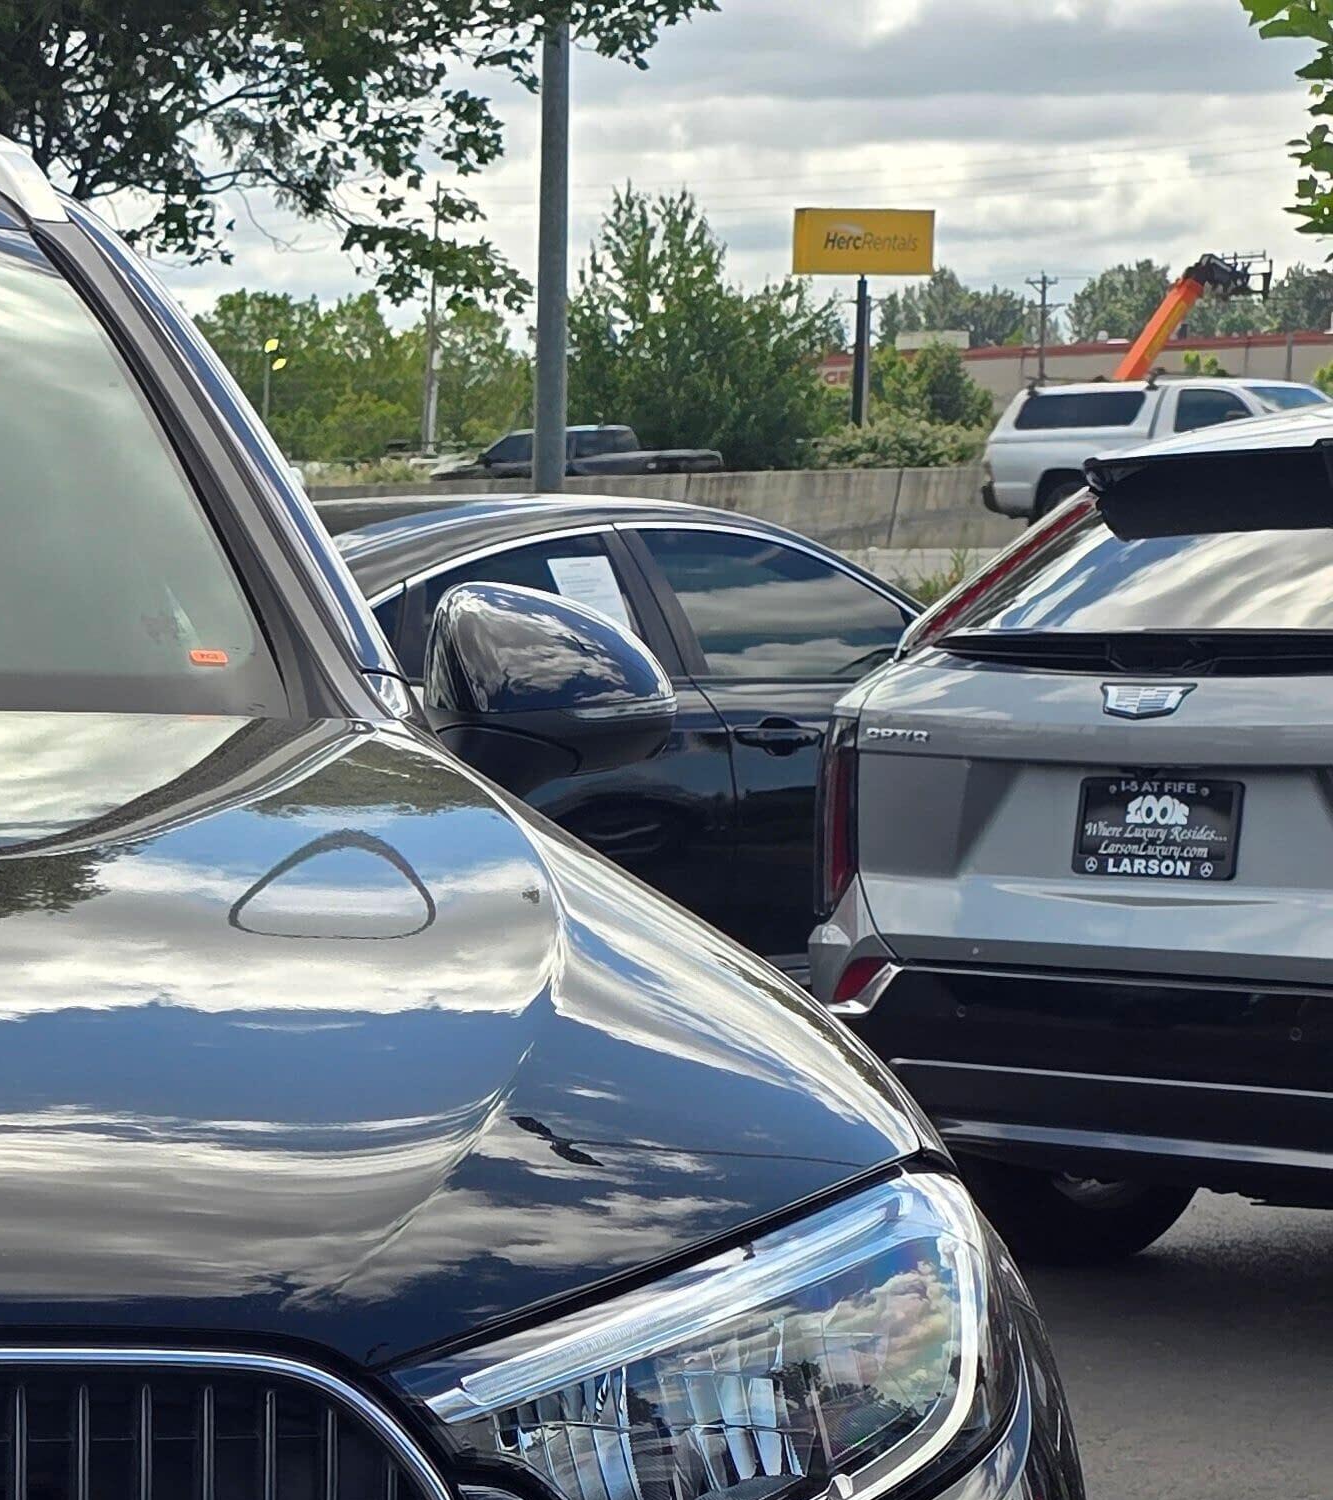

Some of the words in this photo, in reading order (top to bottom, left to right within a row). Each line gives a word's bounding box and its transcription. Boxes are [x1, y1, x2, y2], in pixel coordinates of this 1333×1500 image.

[1121, 781, 1138, 792] I-5
[1141, 781, 1159, 792] AT
[1164, 782, 1197, 793] FIFE
[1085, 821, 1122, 836] Where
[1124, 825, 1167, 842] Luxury
[1098, 840, 1209, 860] LarsonLuxury.com
[1107, 858, 1191, 876] LARSON
